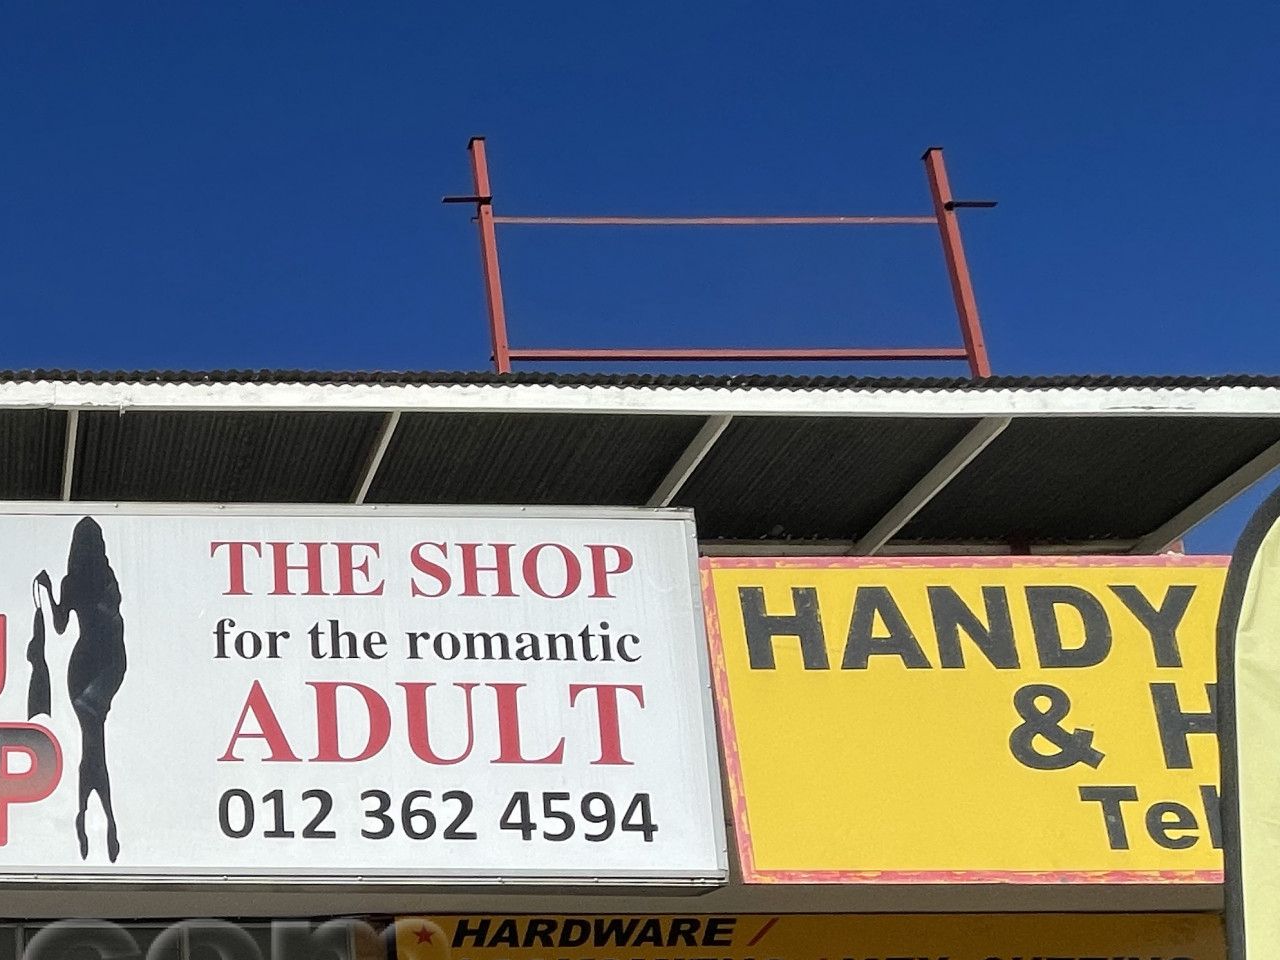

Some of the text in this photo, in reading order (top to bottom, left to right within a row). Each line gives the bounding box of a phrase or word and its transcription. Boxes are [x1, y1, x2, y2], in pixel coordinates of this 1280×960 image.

[210, 541, 634, 599] THE SHOP
[213, 618, 642, 664] for the romantic
[737, 584, 1198, 671] HANDY
[216, 679, 645, 767] ADULT
[1008, 683, 1106, 770] &
[218, 788, 659, 842] 012 362 4594
[450, 917, 737, 948] HARDWARE
